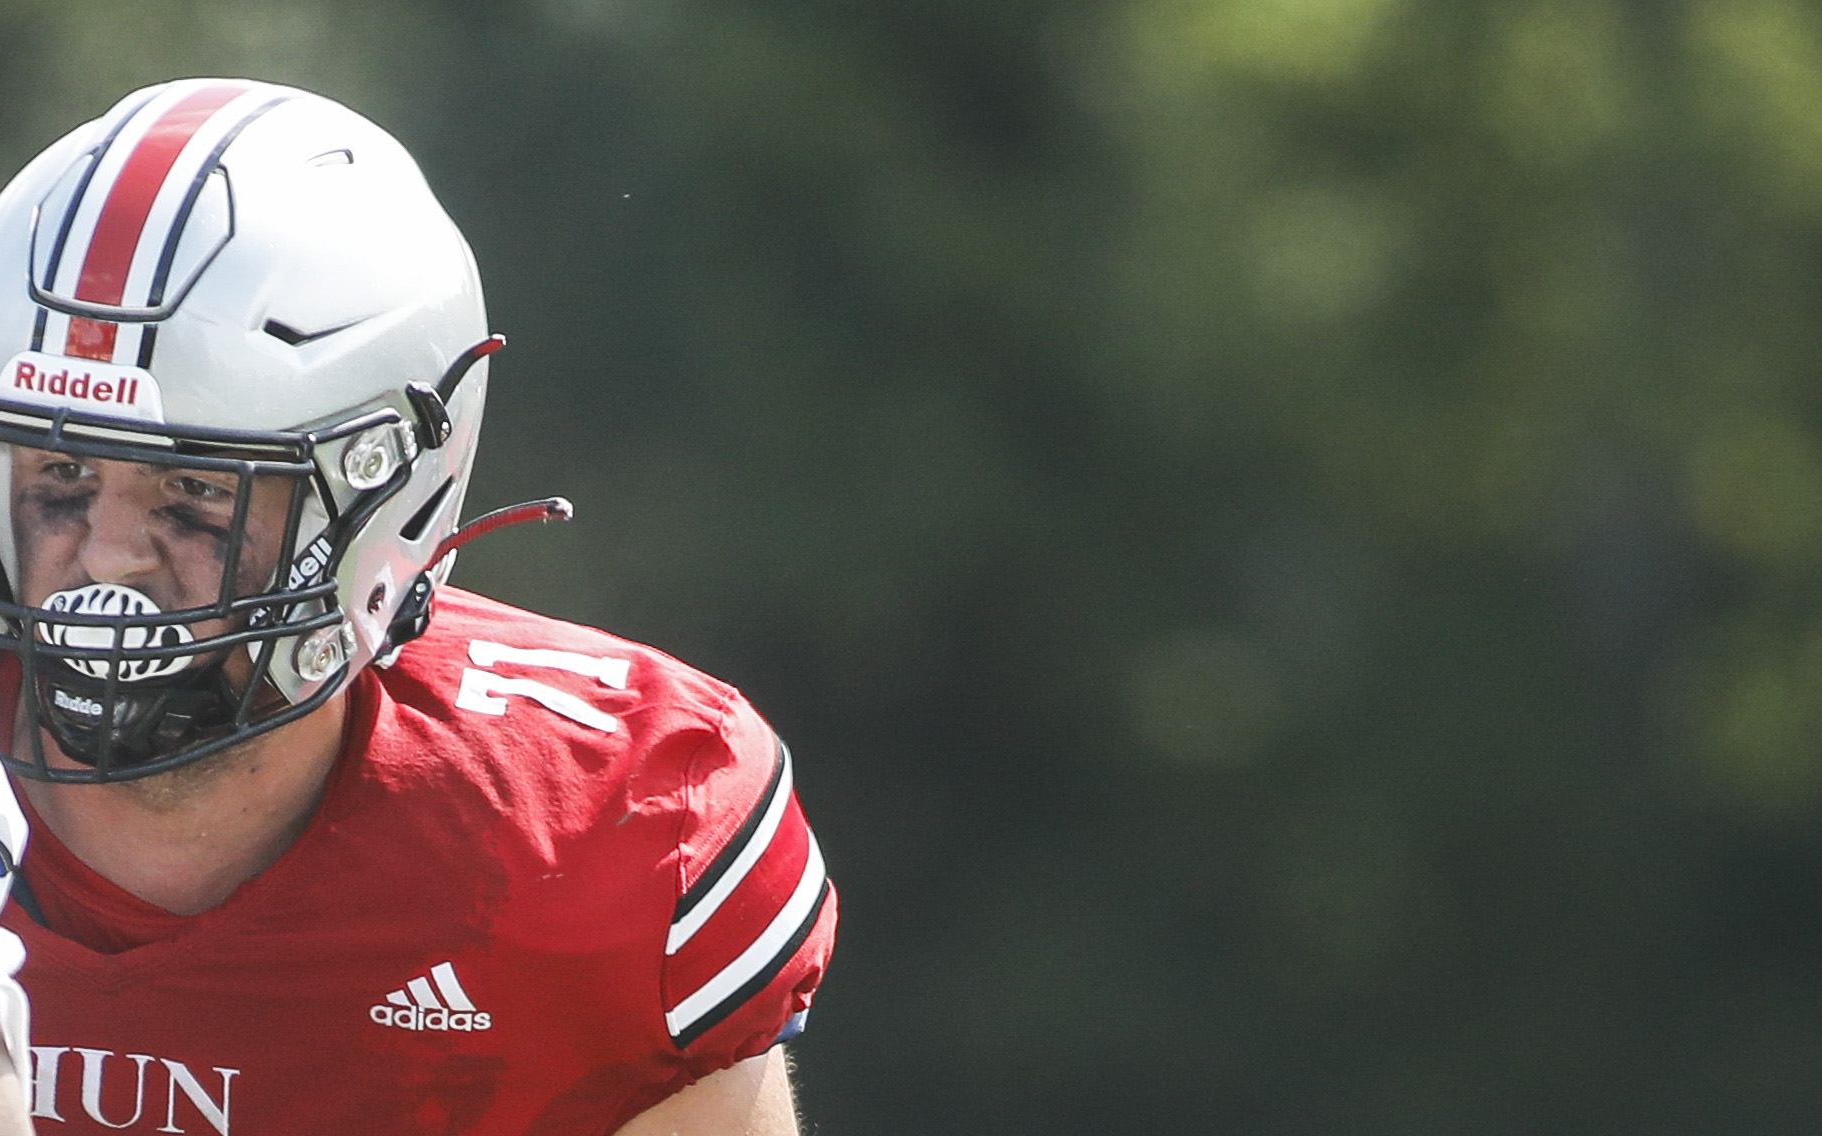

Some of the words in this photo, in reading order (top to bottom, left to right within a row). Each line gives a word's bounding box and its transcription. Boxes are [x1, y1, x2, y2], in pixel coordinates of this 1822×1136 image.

[14, 360, 138, 404] Riddell
[454, 639, 630, 733] 71
[369, 1004, 492, 1032] adidas
